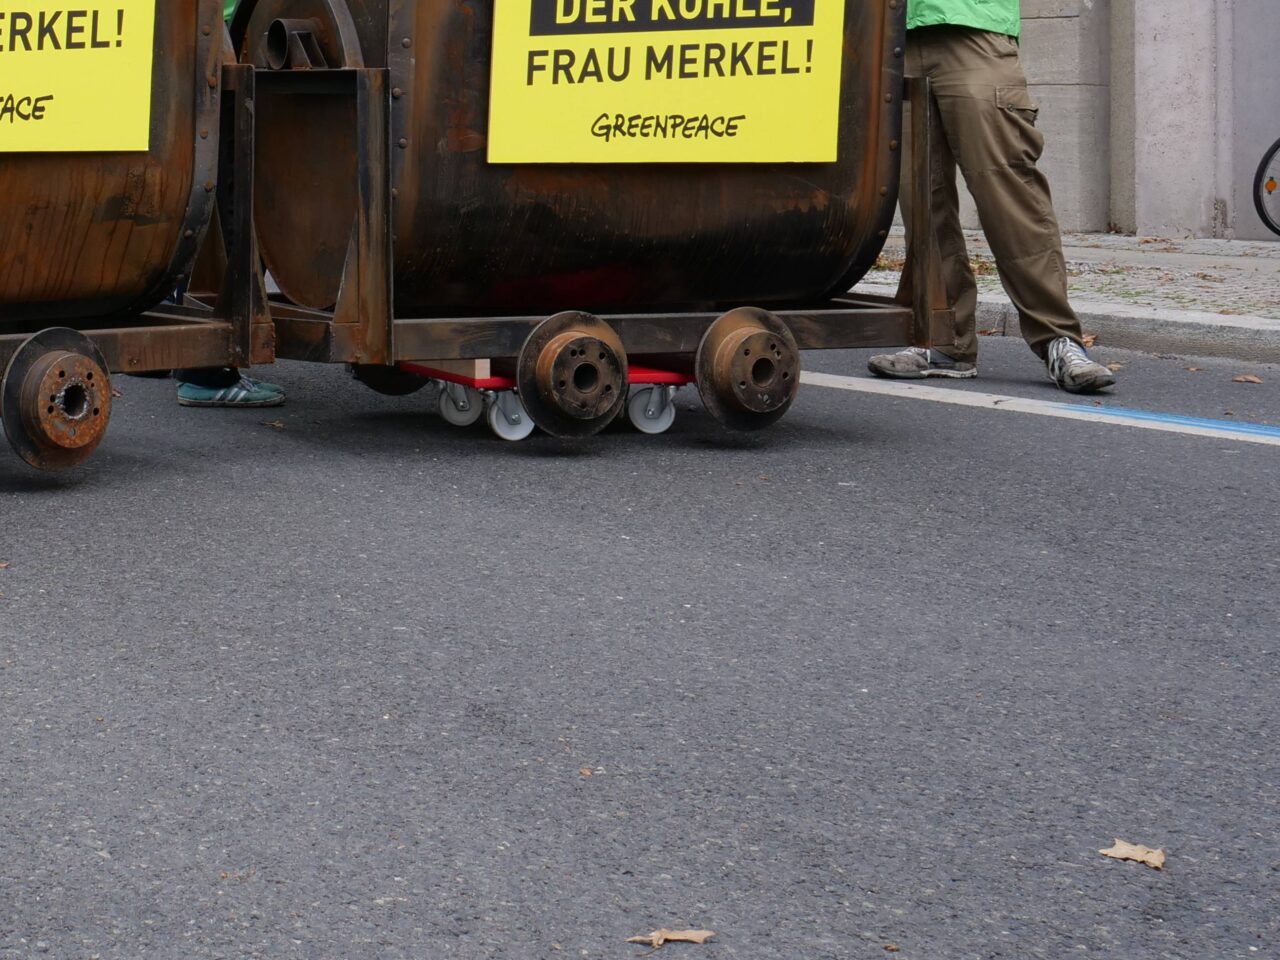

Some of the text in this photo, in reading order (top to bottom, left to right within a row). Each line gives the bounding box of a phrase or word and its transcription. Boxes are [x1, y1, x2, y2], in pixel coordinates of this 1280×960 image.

[526, 39, 813, 86] FRAU MERKEL!
[591, 112, 746, 143] GREENPEACE
